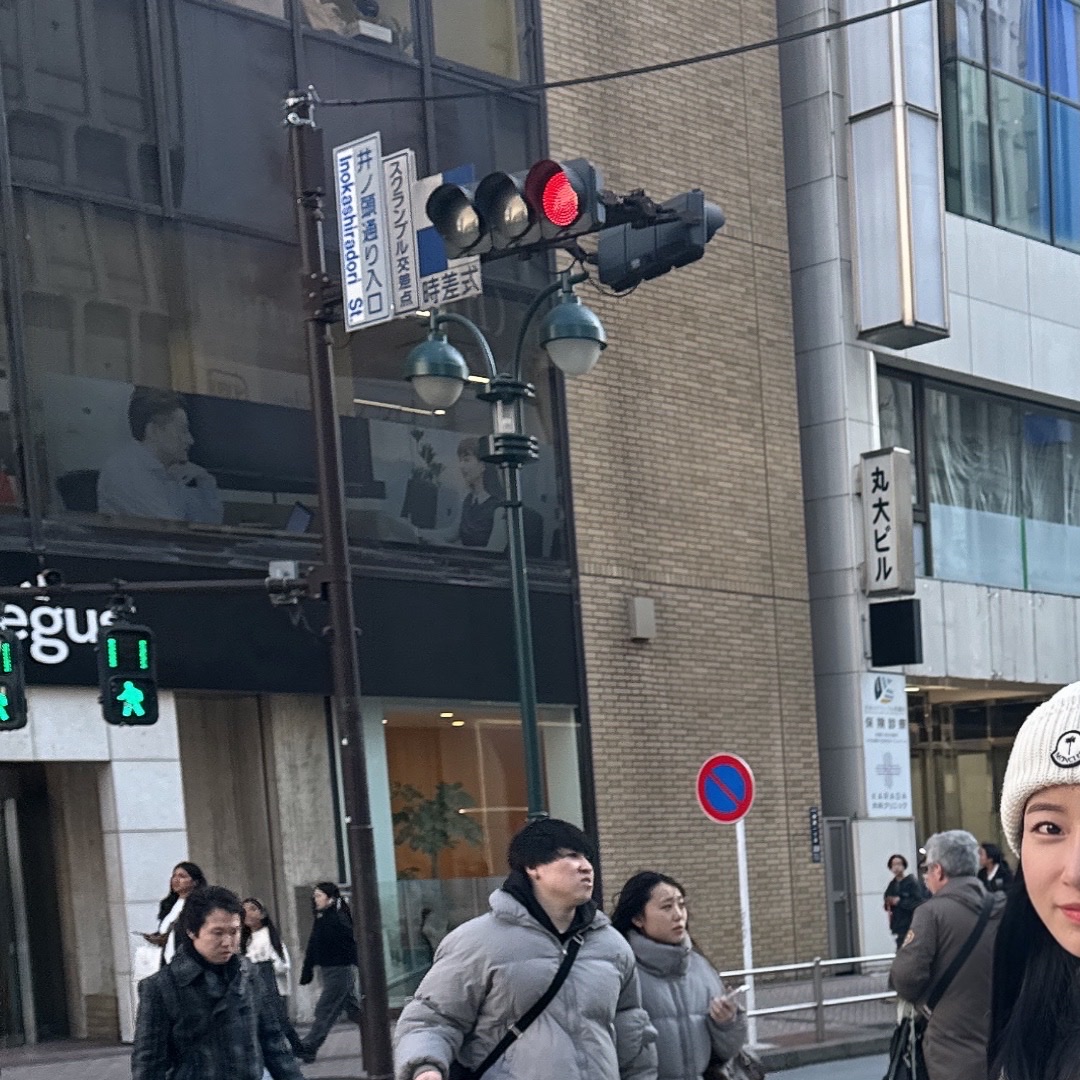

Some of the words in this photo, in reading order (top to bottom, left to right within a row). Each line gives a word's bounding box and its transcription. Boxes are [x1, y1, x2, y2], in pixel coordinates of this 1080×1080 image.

[339, 154, 362, 286] Inokashiradori
[357, 147, 383, 315] 井ノ頭通り入口
[390, 160, 414, 307] スクランブル交差点
[422, 264, 481, 305] 時差式
[871, 466, 893, 582] 丸大ビル
